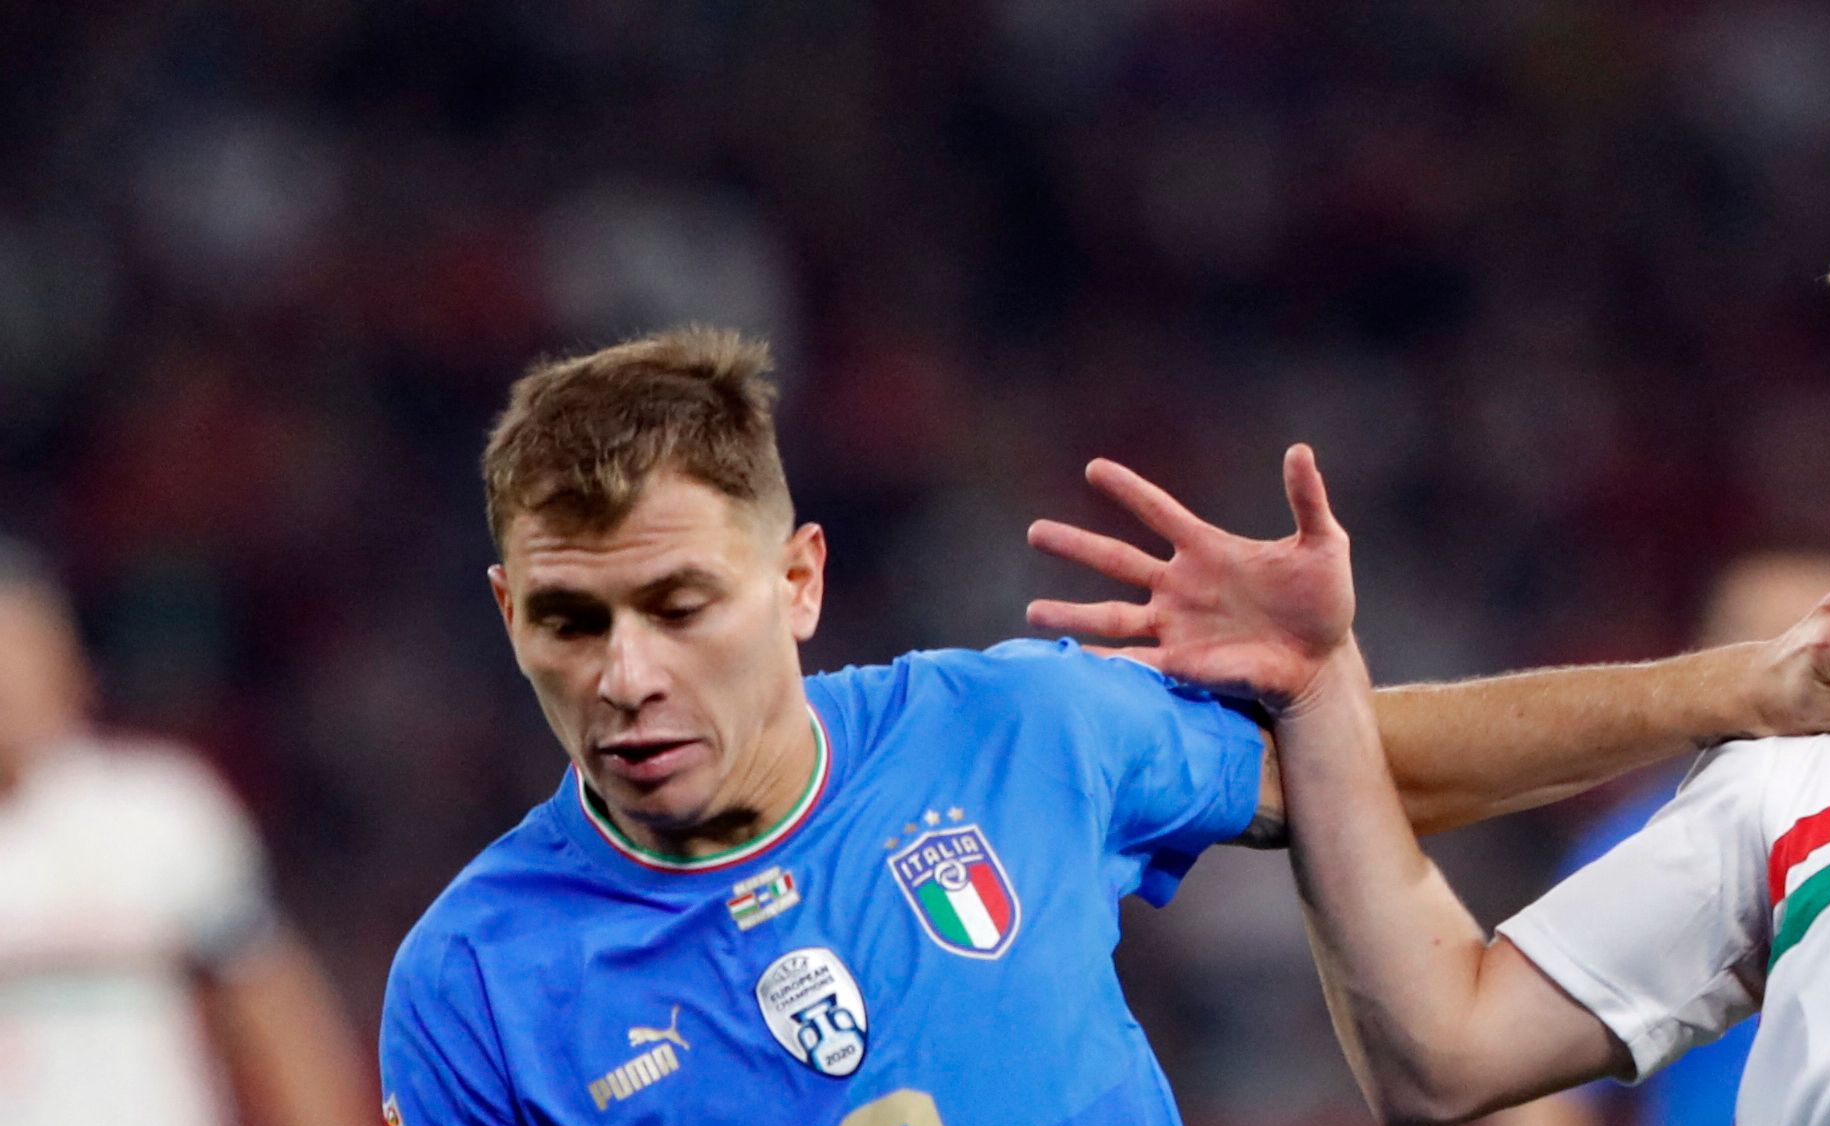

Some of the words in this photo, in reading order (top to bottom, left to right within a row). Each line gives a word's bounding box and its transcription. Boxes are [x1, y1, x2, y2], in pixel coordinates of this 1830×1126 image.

[901, 836, 979, 880] ITALIA
[770, 964, 829, 1002] EUROPEAN
[775, 974, 836, 1012] CHAMPIONS
[824, 1044, 856, 1066] 2020
[588, 1043, 679, 1111] PUMA
